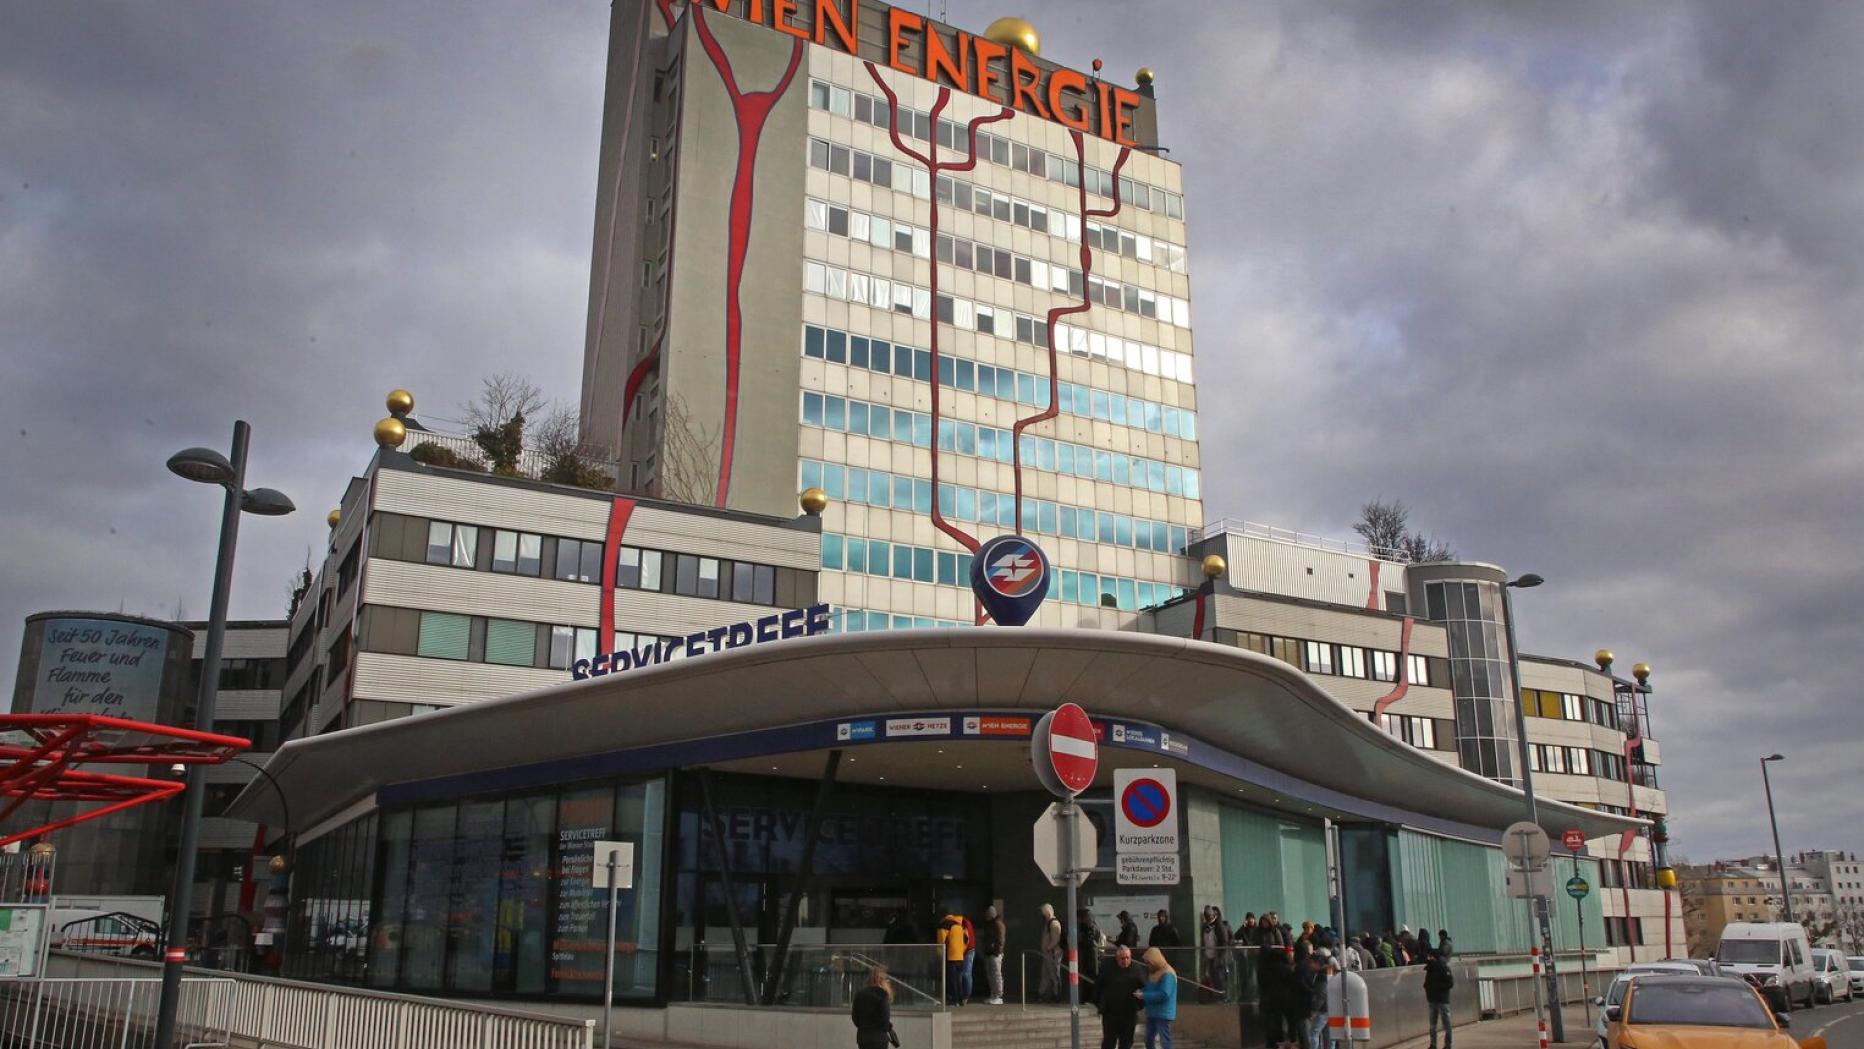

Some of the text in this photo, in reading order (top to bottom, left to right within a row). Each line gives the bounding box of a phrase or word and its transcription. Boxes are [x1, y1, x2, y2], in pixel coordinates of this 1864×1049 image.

[690, 0, 1141, 147] EN ENERGIE
[79, 629, 101, 644] 50
[105, 629, 161, 649] Jahren
[60, 647, 146, 668] Feuer und
[47, 666, 112, 684] Flamme
[61, 686, 124, 707] für den
[560, 828, 606, 841] SERVICETREFF
[1119, 834, 1175, 846] Kurzparkzone
[1121, 856, 1175, 864] gebührenpflichtig
[1122, 865, 1155, 873] Parkdauer:
